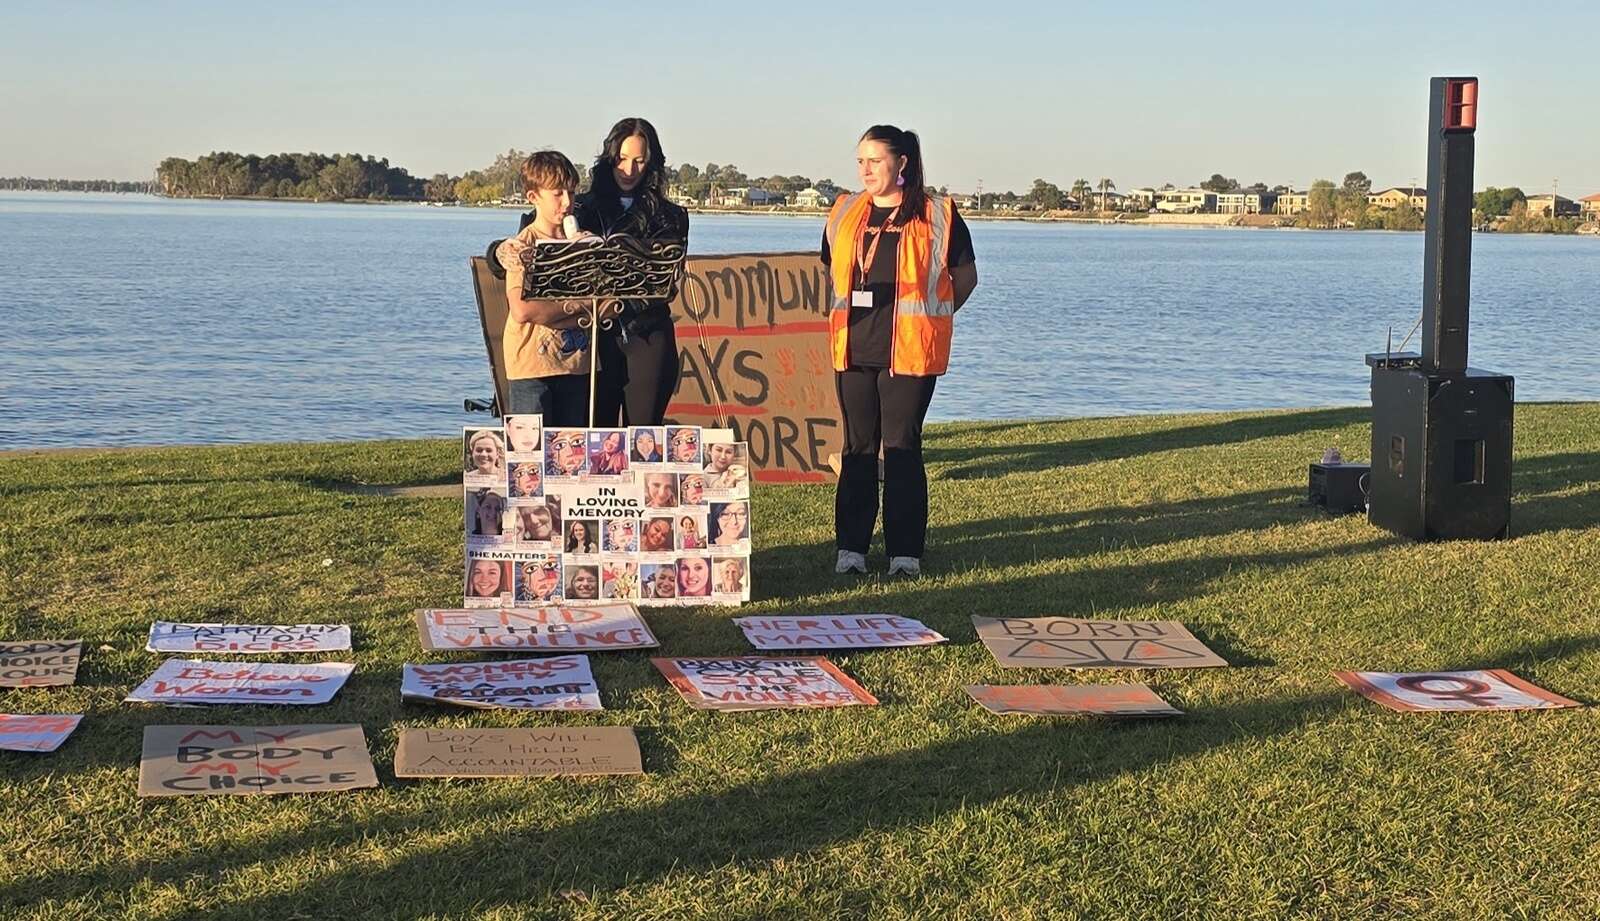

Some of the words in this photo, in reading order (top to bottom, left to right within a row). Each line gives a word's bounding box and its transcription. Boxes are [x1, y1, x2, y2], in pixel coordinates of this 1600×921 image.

[669, 259, 832, 331] OMMUNI
[673, 338, 769, 406] AYS
[598, 487, 616, 496] IN
[576, 497, 638, 507] LOVING
[568, 508, 646, 518] MEMORY
[491, 552, 547, 560] MATTERS
[434, 608, 604, 626] END
[739, 619, 827, 631] HER
[831, 617, 919, 630] LIFE
[469, 624, 572, 634] THE
[996, 618, 1169, 637] BORN
[252, 634, 320, 642] FOR
[443, 627, 642, 646] VIOLENCE
[195, 641, 315, 650] DICKS
[412, 657, 579, 675] WOMENS
[175, 667, 332, 683] Believe
[418, 671, 557, 684] SAFETY
[701, 675, 824, 686] STOP
[154, 680, 316, 696] Women
[736, 684, 800, 692] THE
[702, 690, 852, 702] VIOLENCE
[179, 729, 301, 744] MY
[176, 745, 347, 763] BODY
[185, 760, 301, 775] MY
